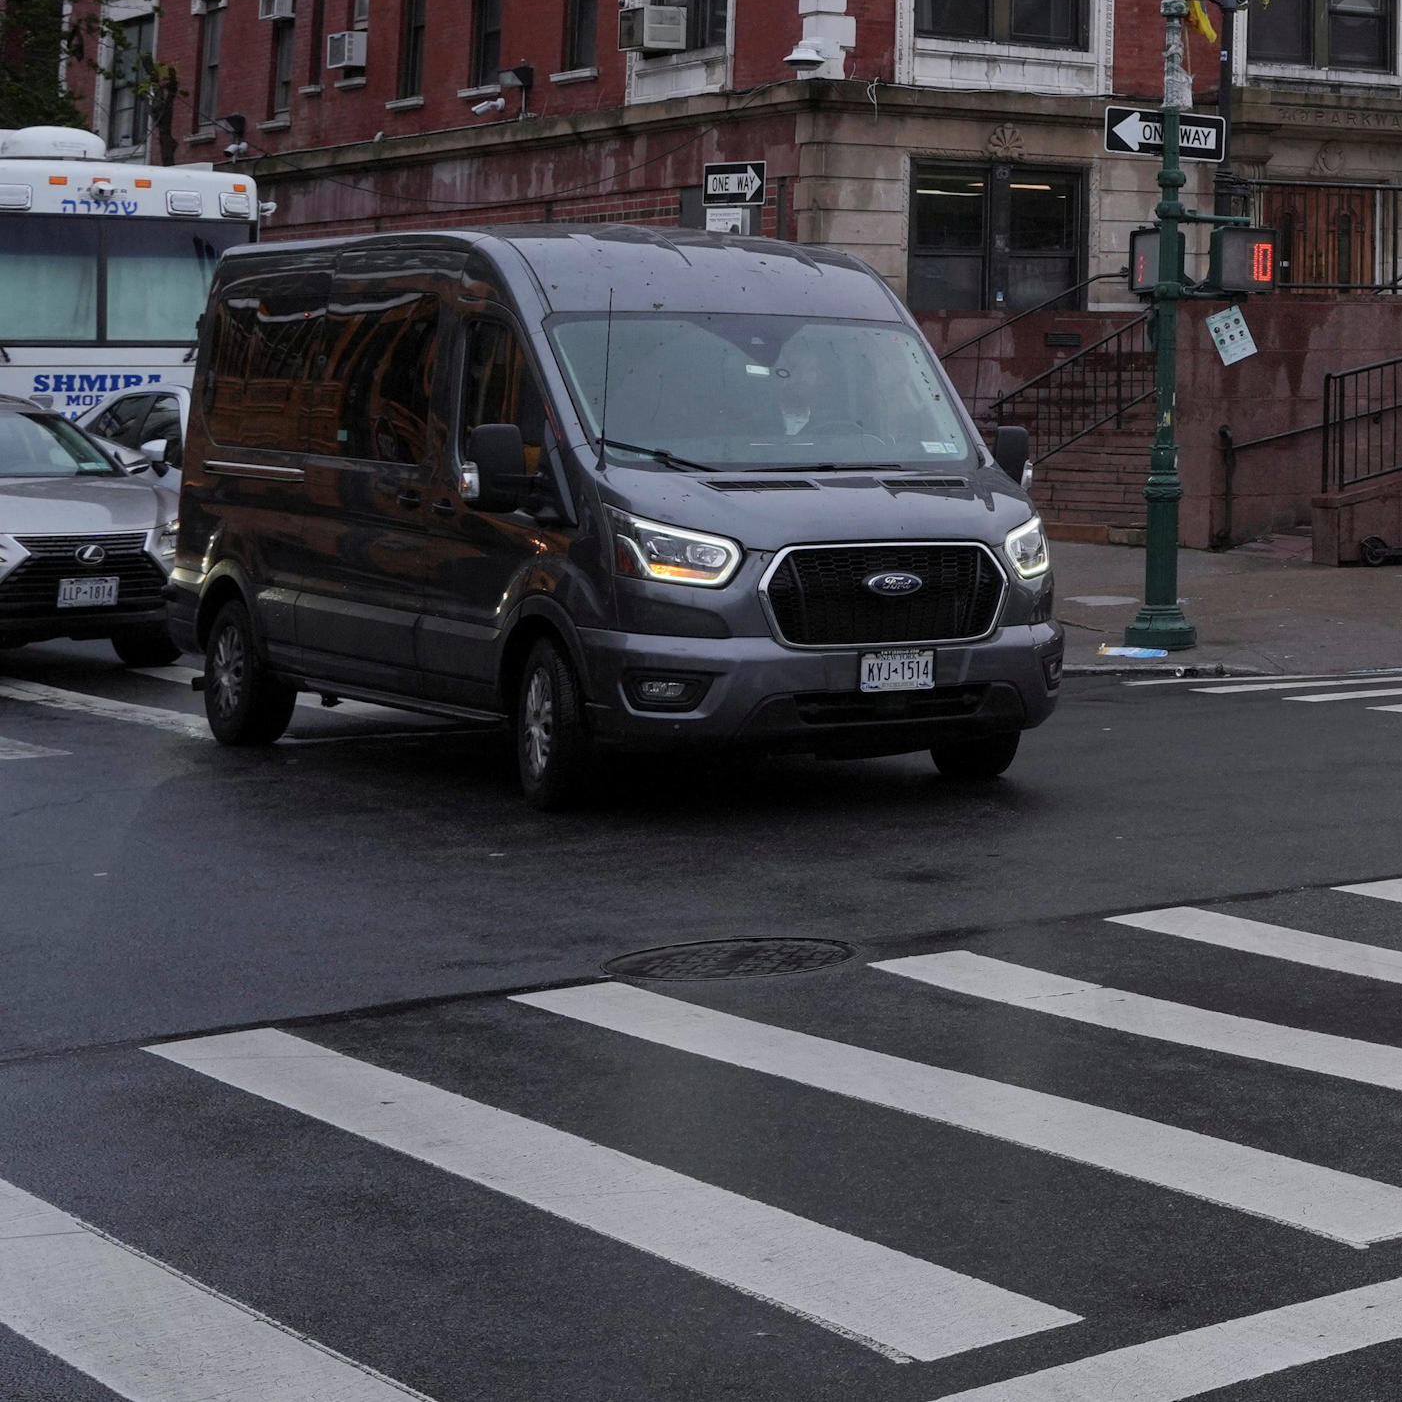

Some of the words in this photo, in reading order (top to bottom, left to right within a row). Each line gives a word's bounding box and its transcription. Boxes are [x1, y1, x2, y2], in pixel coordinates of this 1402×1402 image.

[1142, 124, 1163, 142] ON
[1180, 127, 1211, 146] WAY
[712, 176, 730, 192] ONE
[737, 175, 756, 191] WAY
[61, 199, 138, 216] שמירה
[1253, 243, 1273, 281] 10
